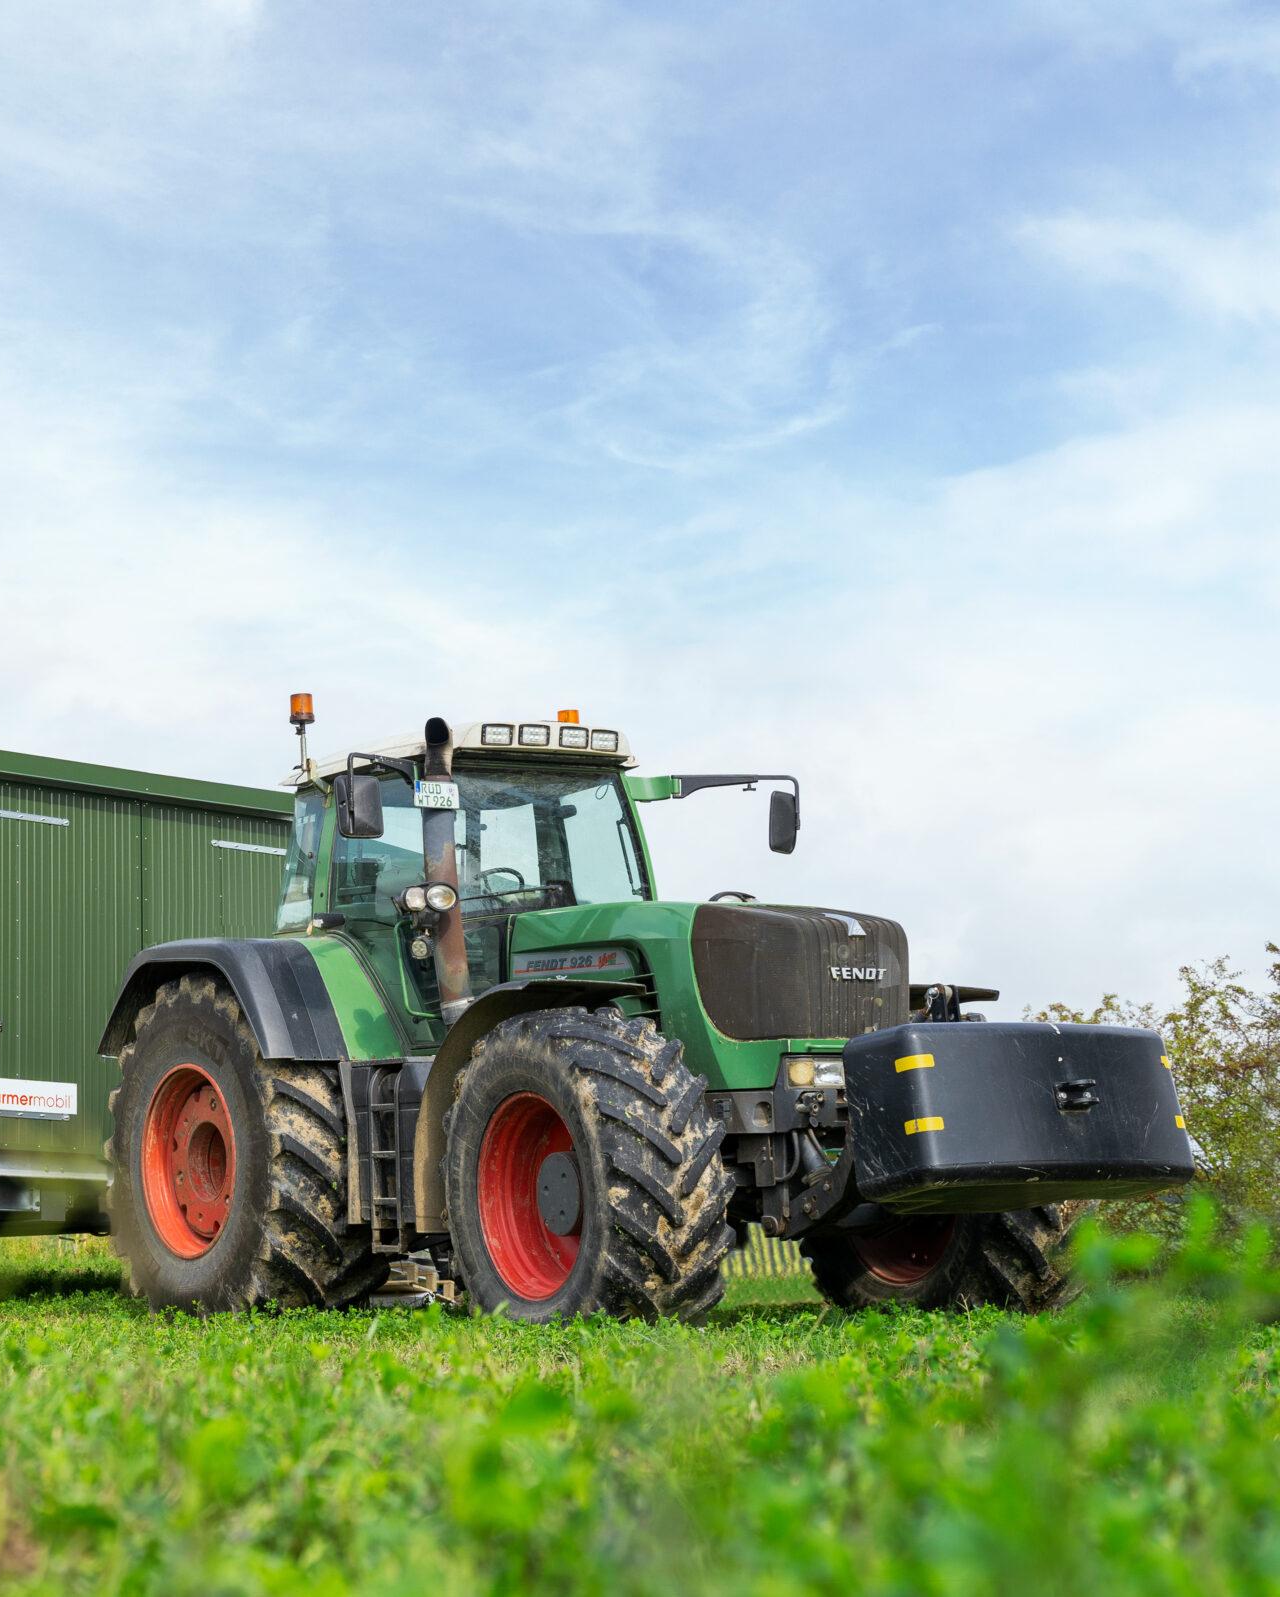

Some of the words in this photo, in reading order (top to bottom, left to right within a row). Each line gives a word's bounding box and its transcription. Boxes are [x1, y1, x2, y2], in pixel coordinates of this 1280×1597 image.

[421, 783, 442, 795] RÜD
[417, 795, 431, 806] WT
[433, 796, 453, 808] 926
[526, 957, 568, 972] FENDT
[570, 954, 593, 969] 926
[830, 966, 888, 981] FENDT
